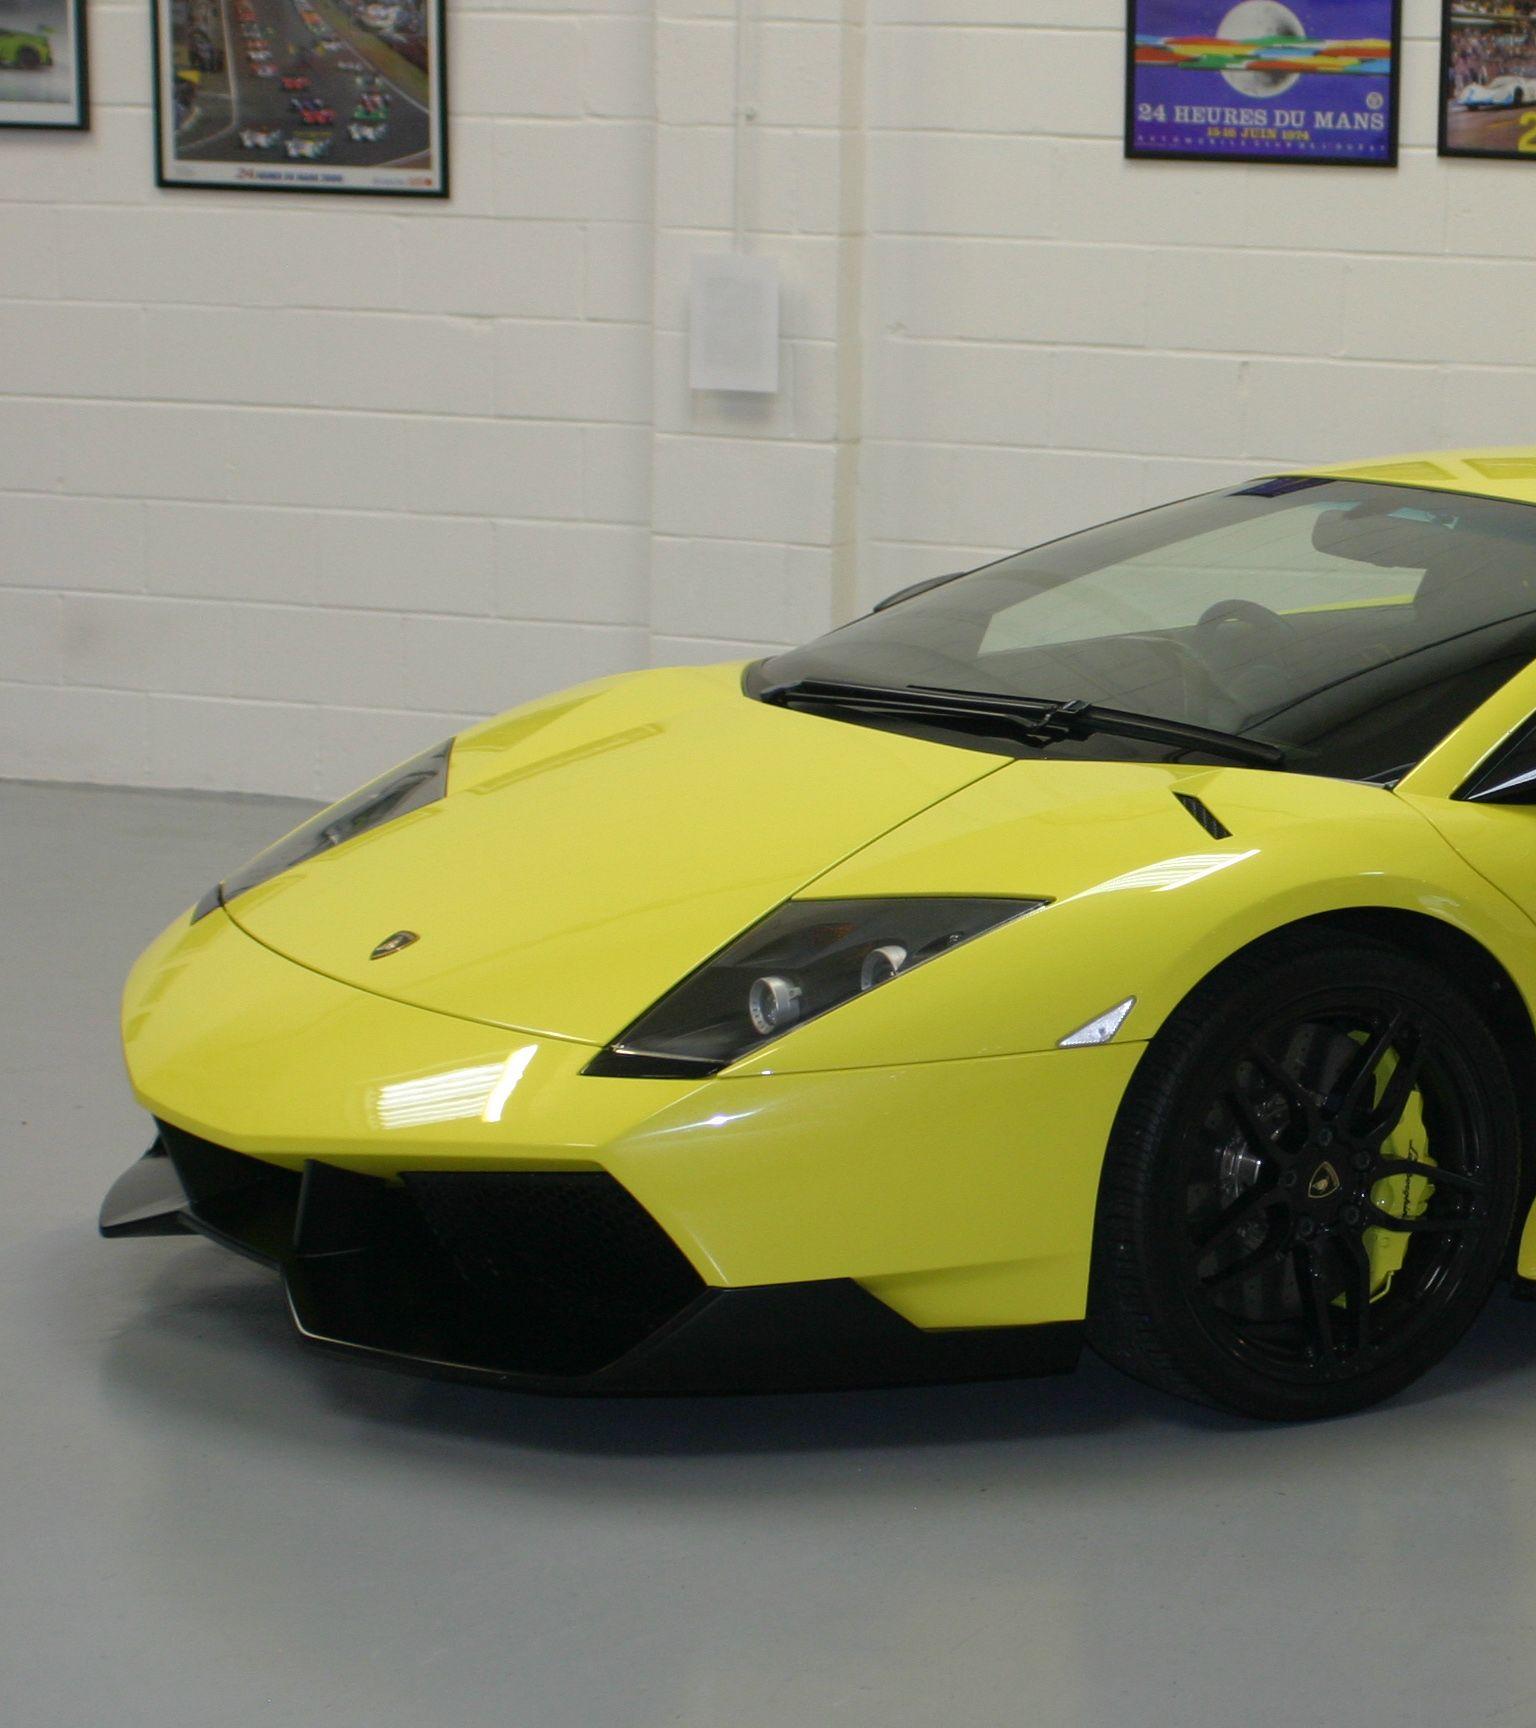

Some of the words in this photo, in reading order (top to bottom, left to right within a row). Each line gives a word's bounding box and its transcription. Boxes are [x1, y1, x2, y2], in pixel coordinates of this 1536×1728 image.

[1138, 103, 1166, 122] 24
[1174, 105, 1268, 126] HEURES
[1274, 109, 1306, 128] DU
[1314, 111, 1385, 131] MANS
